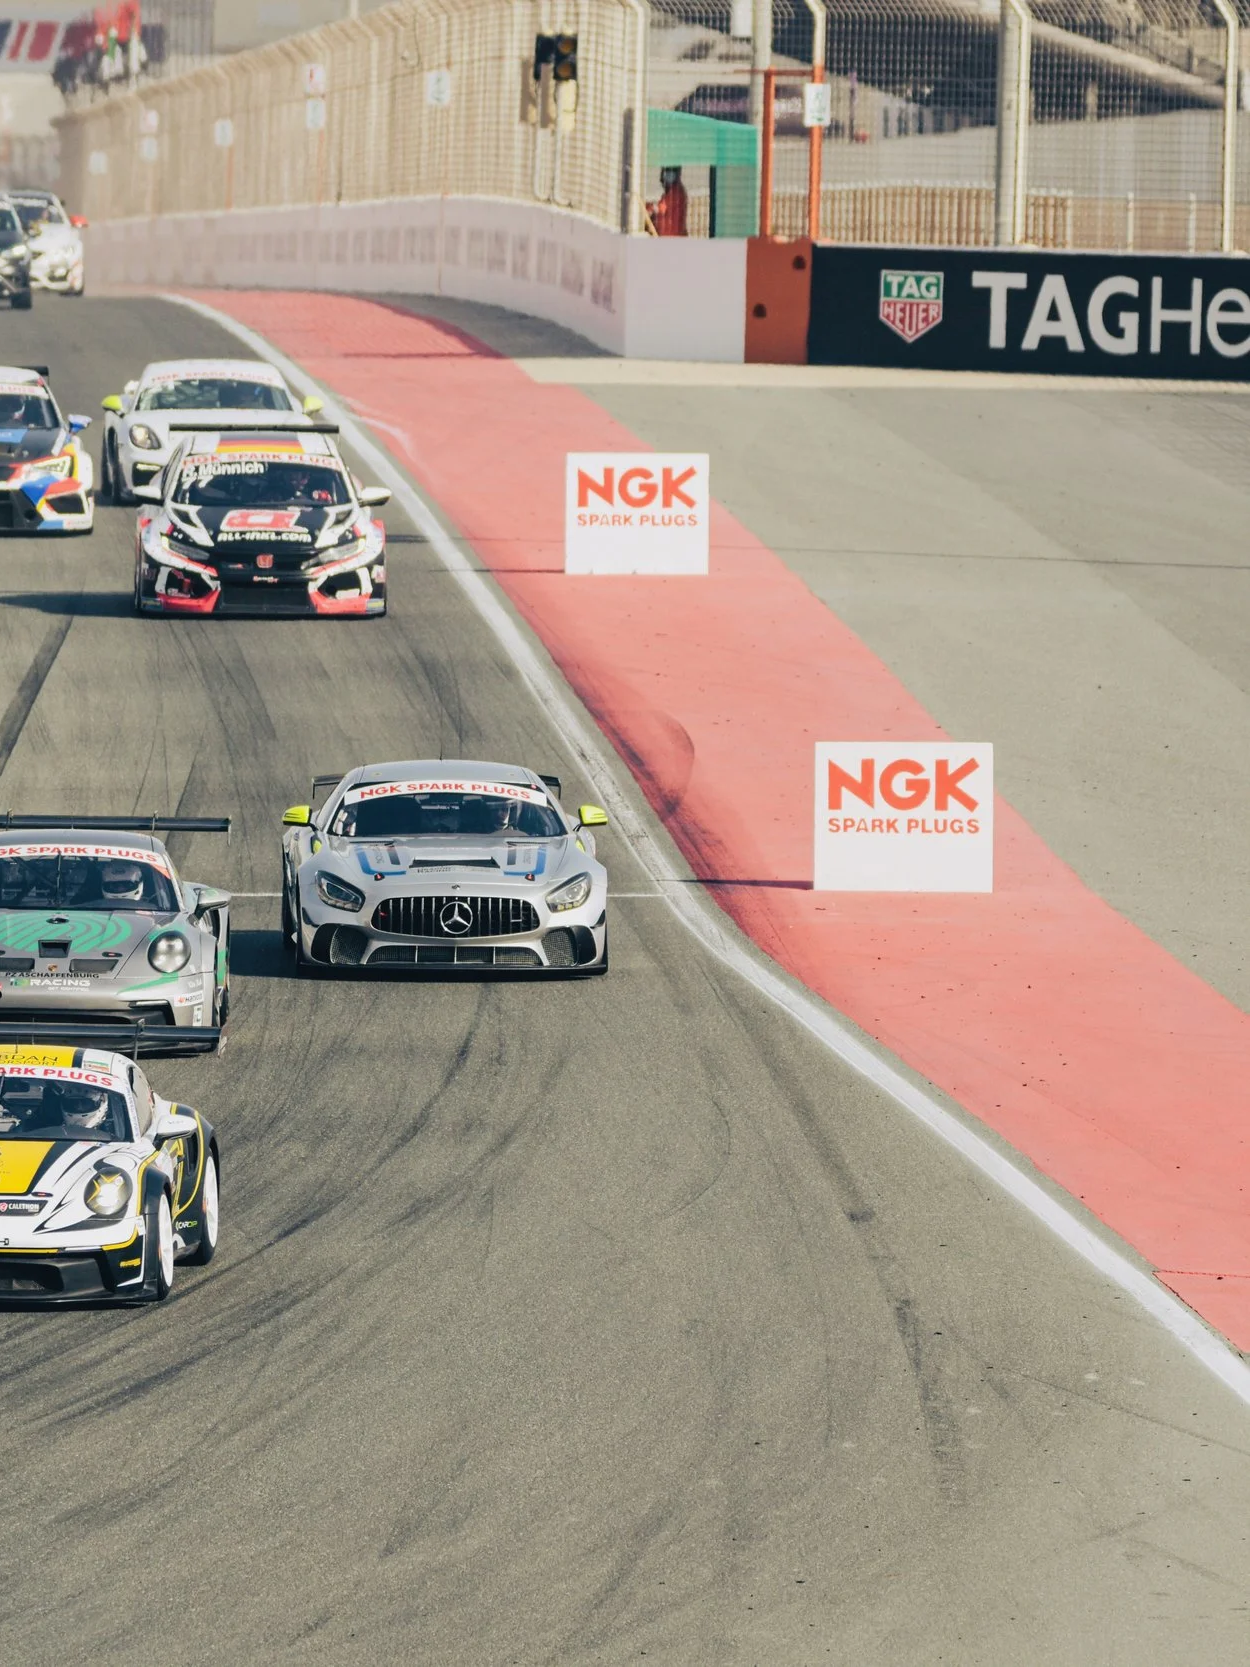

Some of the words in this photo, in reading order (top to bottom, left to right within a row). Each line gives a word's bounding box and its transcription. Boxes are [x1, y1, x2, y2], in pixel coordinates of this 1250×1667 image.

[885, 274, 938, 299] TAG
[882, 301, 941, 337] HEUER
[577, 466, 697, 509] NGK
[577, 513, 633, 527] SPARK
[639, 513, 698, 527] PLUGS
[360, 784, 403, 799] NGK
[406, 782, 465, 791] SPARK
[471, 784, 531, 799] PLUGS
[828, 757, 980, 813] NGK
[828, 818, 900, 834] SPARK
[907, 818, 980, 834] PLUGS
[26, 846, 87, 855] SPARK
[94, 847, 158, 863] PLUGS
[30, 979, 91, 987] RACING
[44, 1068, 114, 1087] PLUGS
